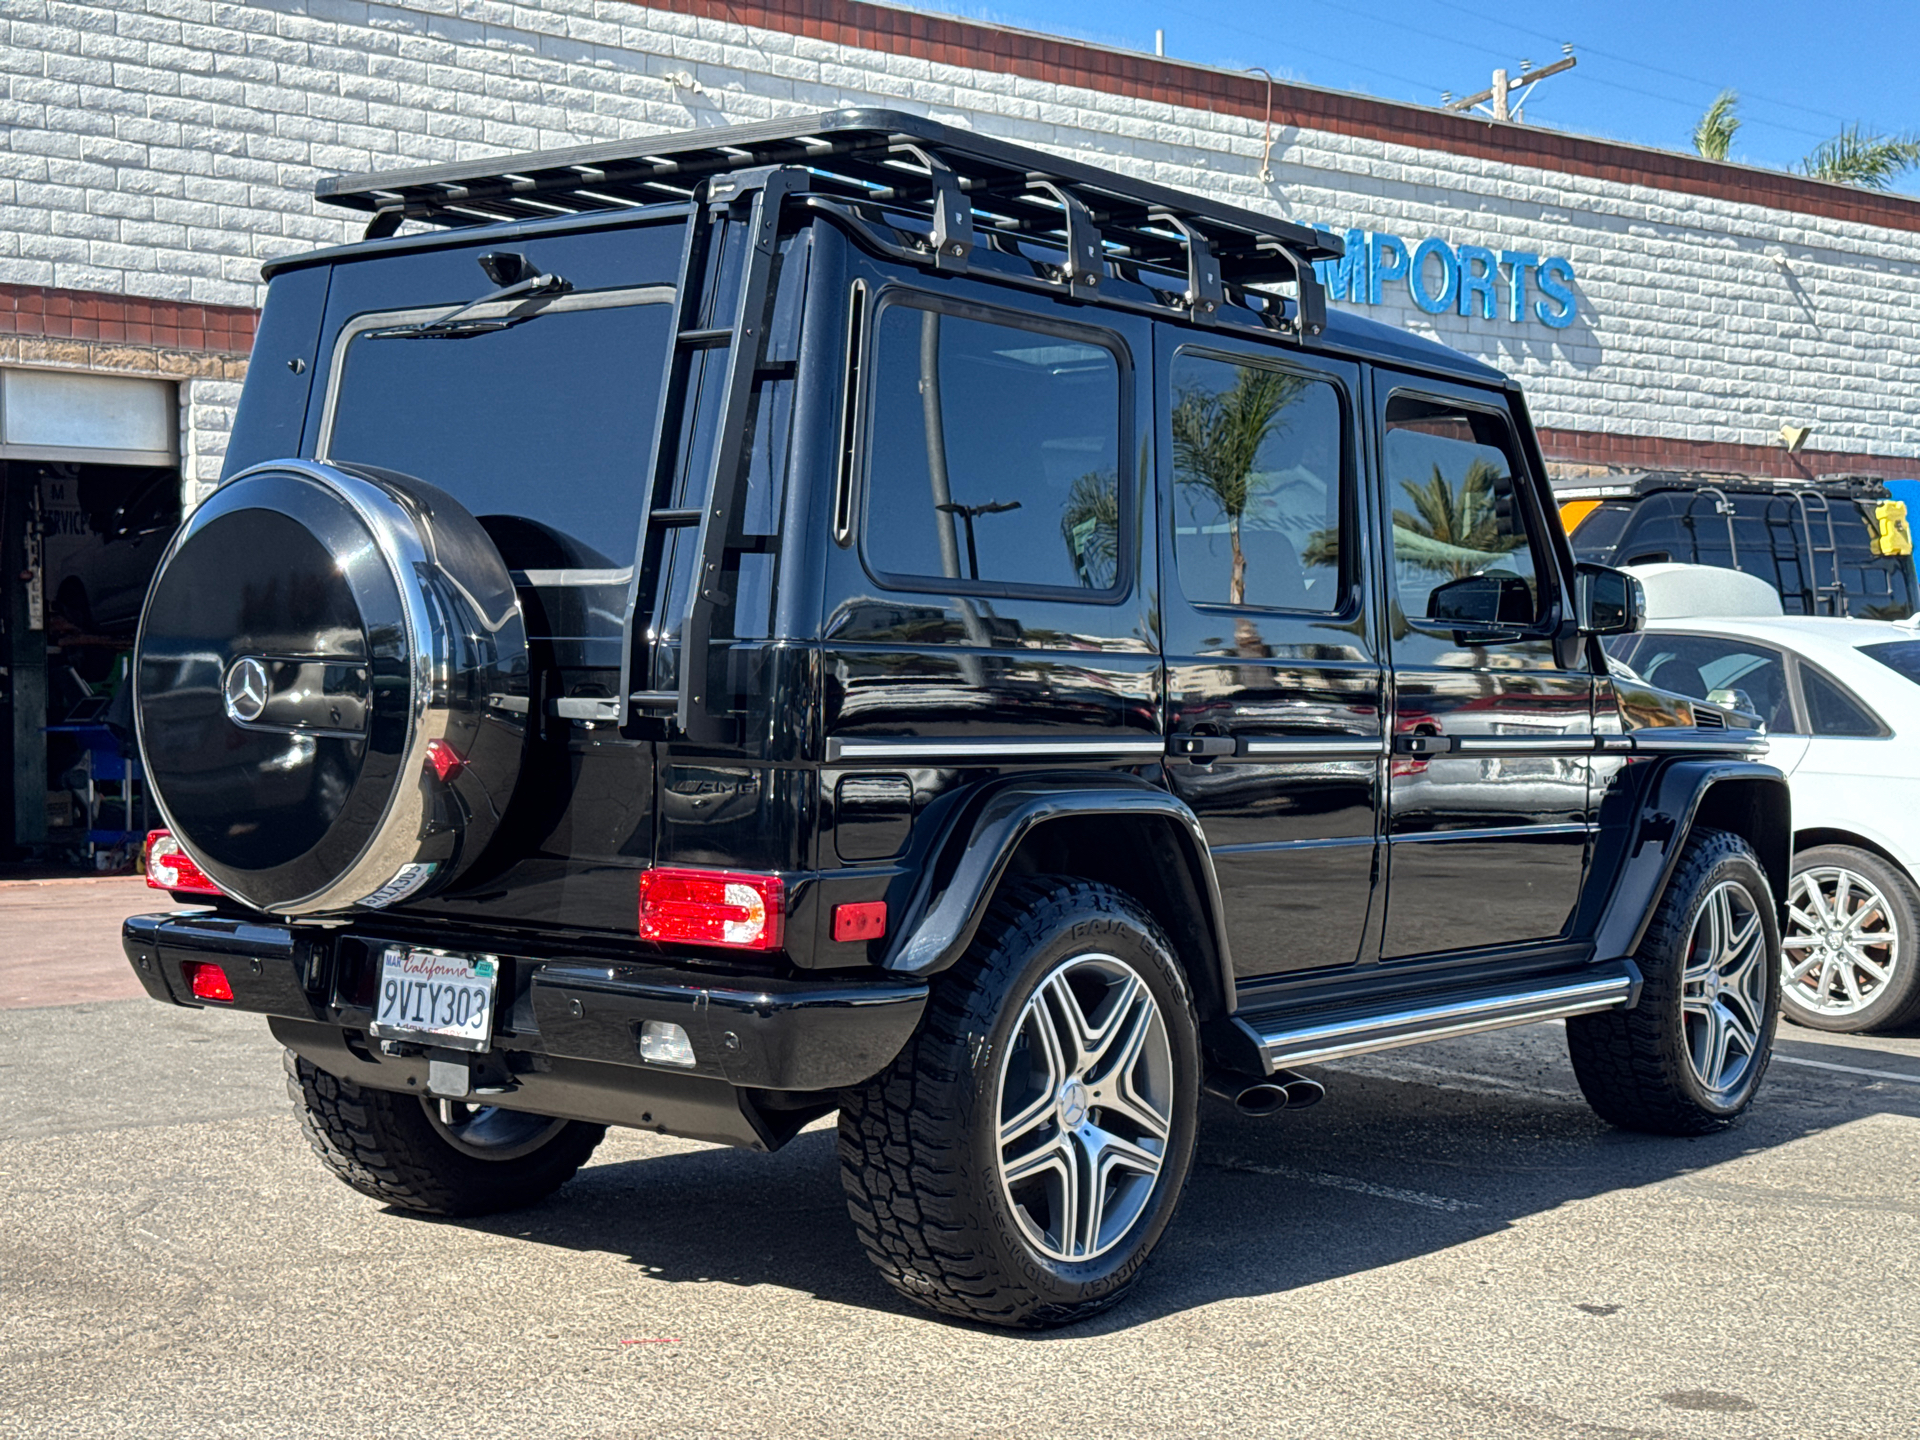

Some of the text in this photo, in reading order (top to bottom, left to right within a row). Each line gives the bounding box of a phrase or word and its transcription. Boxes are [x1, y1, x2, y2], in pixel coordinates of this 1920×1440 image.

[1294, 220, 1577, 329] MPORTS
[697, 780, 758, 795] AMG
[386, 954, 401, 968] MAR
[403, 955, 475, 981] California
[382, 980, 486, 1029] 9VIY303
